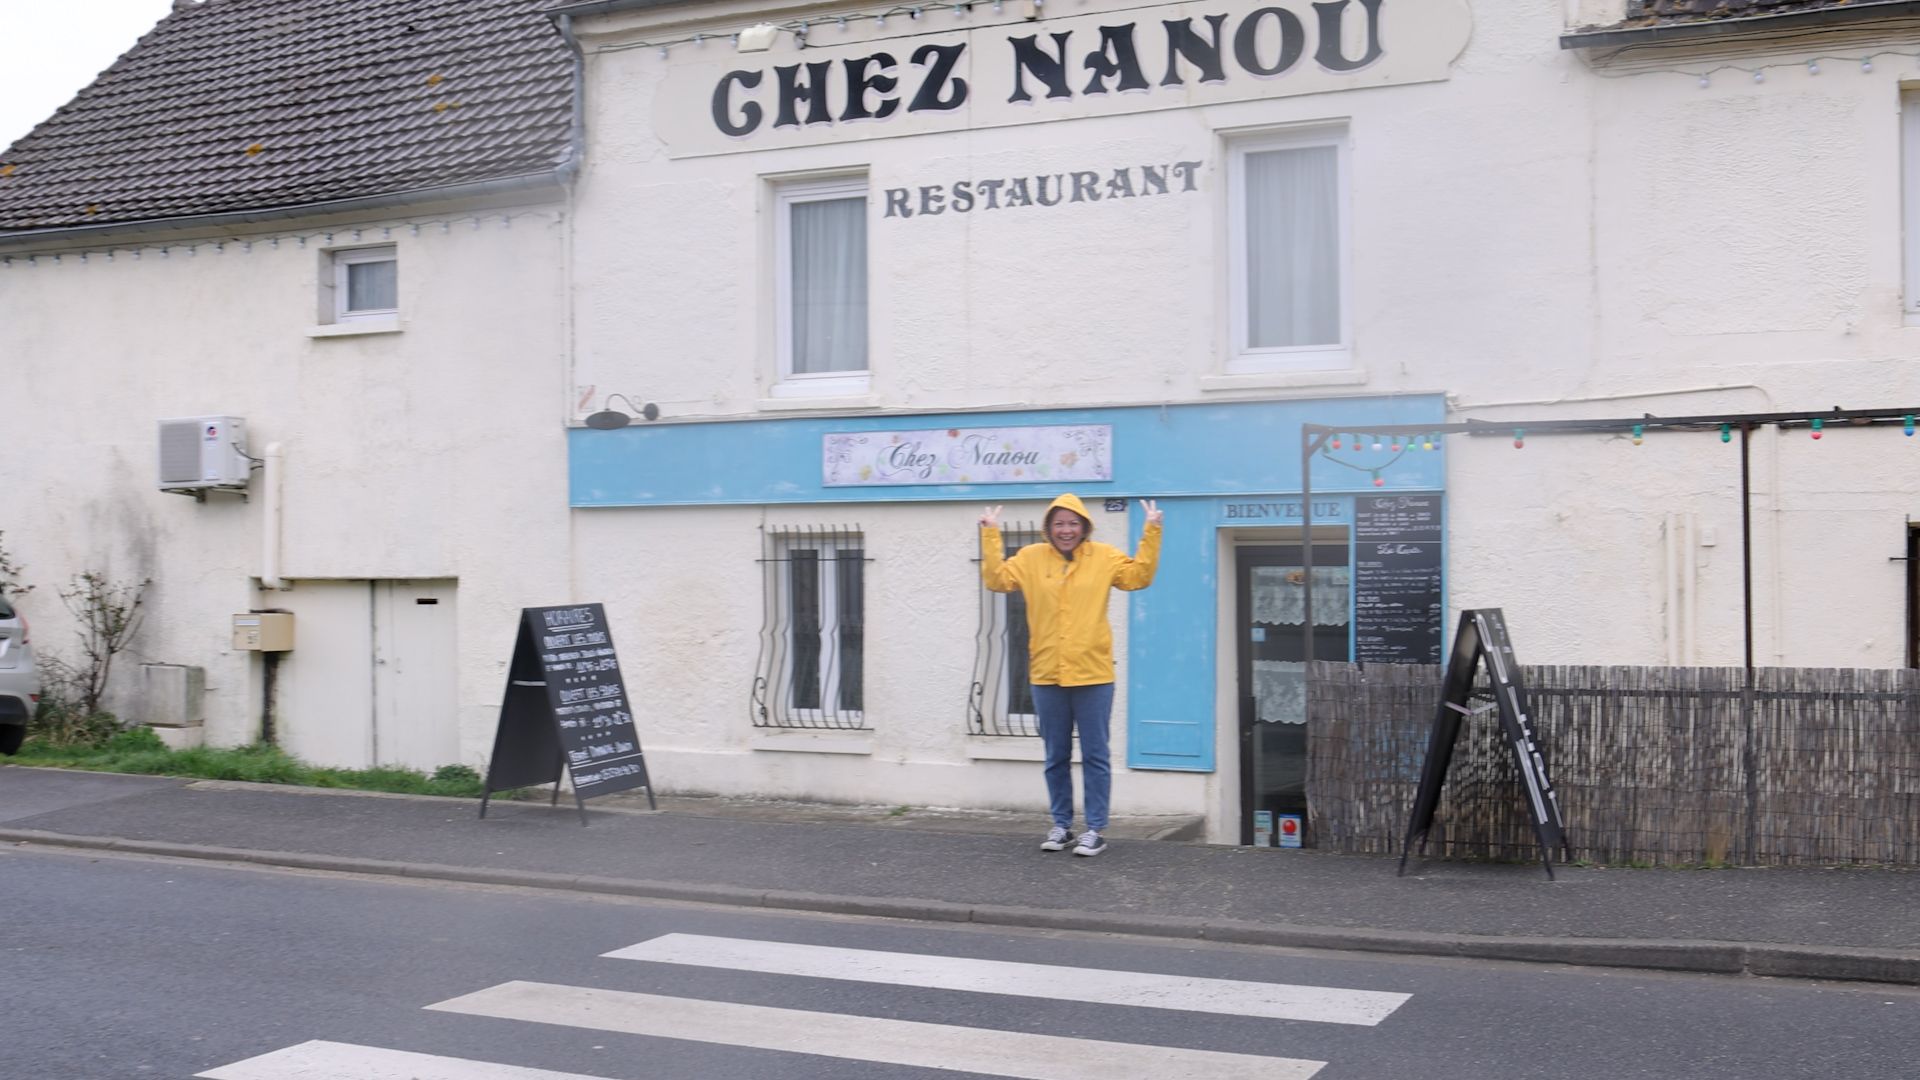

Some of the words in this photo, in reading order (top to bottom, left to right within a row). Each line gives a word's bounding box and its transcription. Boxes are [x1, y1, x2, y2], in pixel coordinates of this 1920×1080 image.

[711, 42, 969, 136] CHEZ
[1007, 0, 1383, 105] NANOU
[884, 160, 1204, 219] RESTAURANT
[877, 441, 936, 479] Chez
[949, 434, 1040, 469] Nanou
